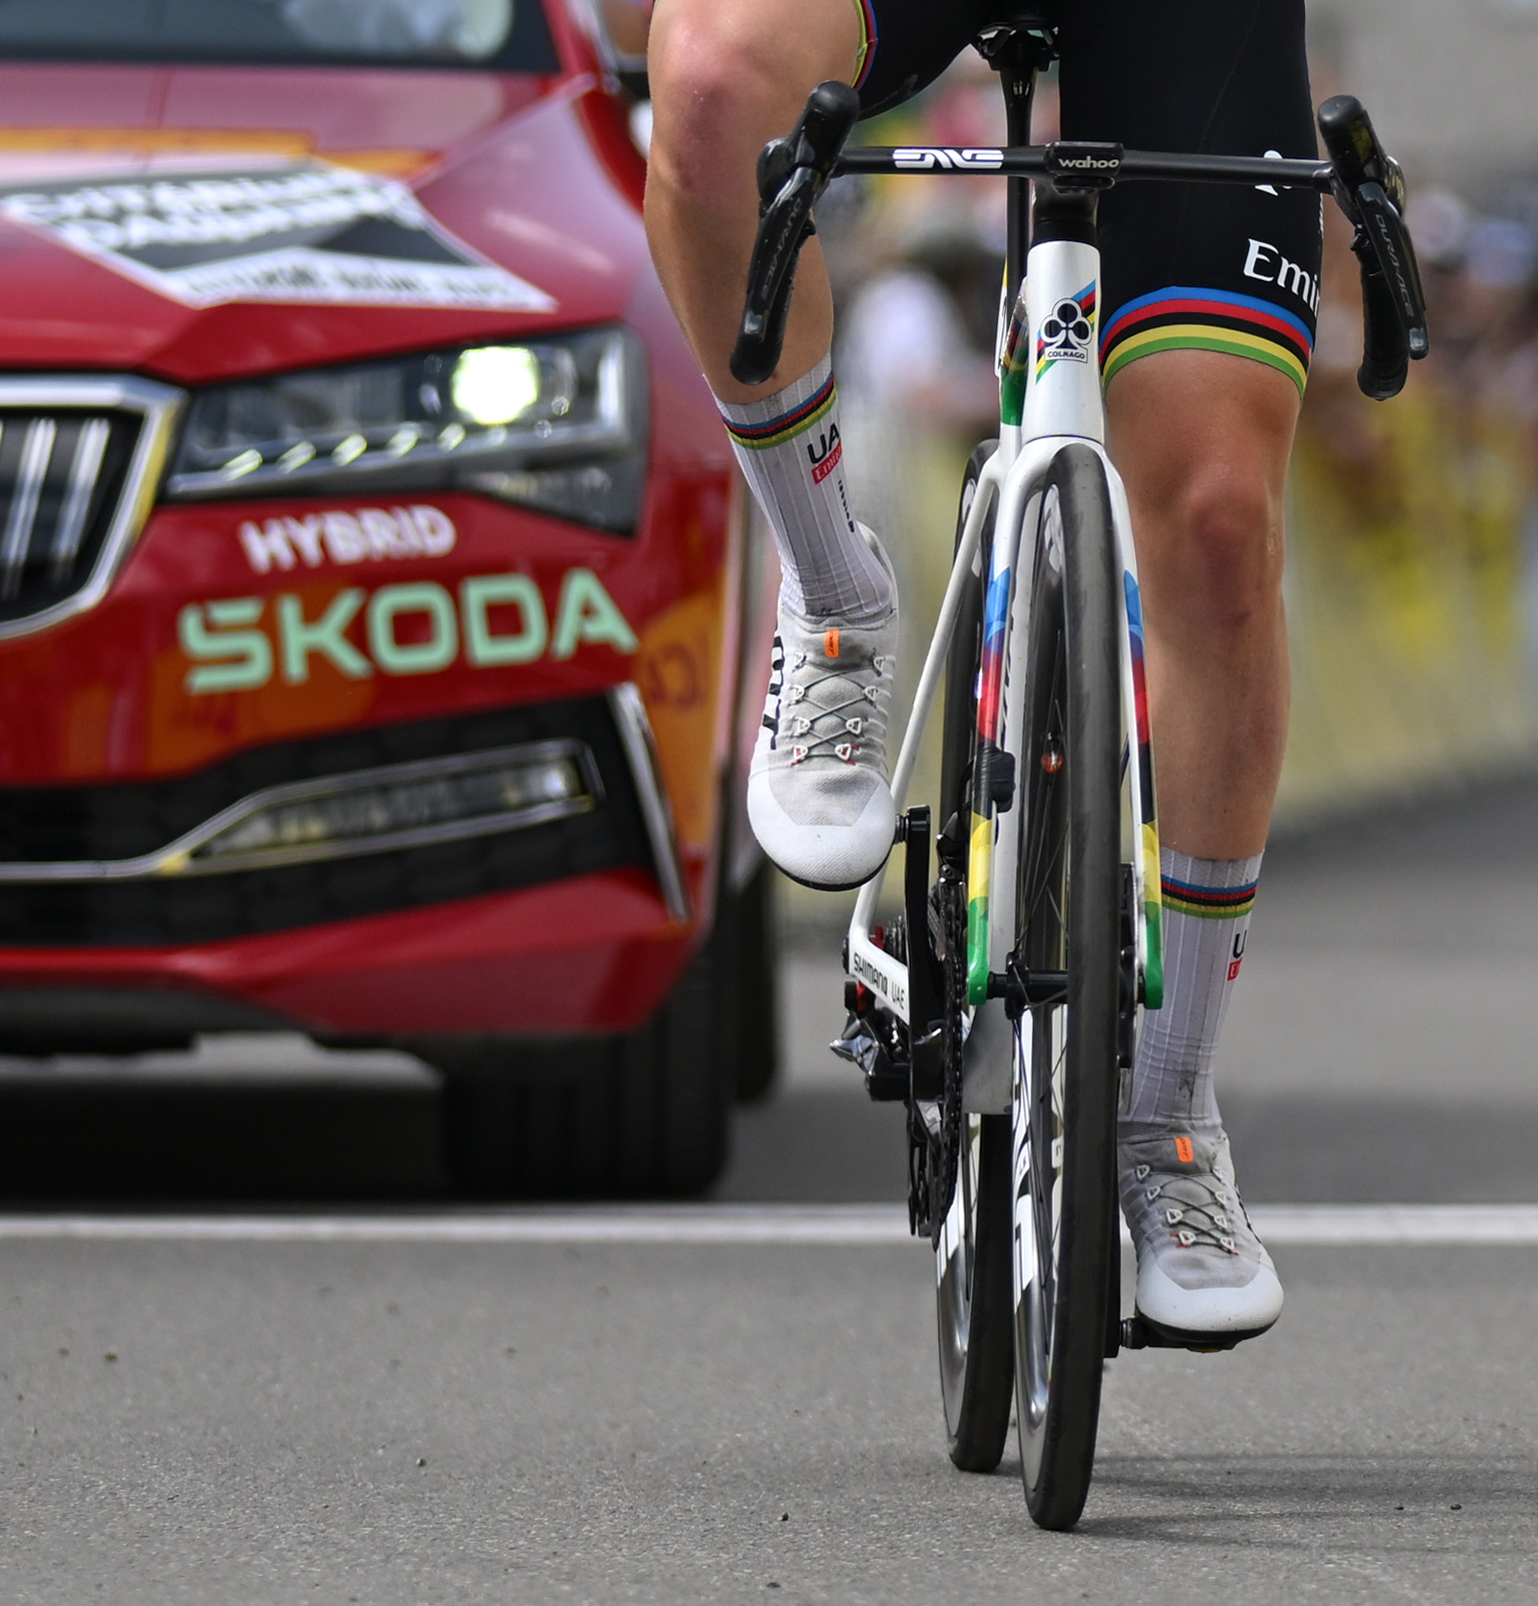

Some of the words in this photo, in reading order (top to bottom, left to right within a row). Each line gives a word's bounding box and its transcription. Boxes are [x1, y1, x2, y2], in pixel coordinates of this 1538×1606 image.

[1058, 156, 1121, 170] wahoo
[1046, 350, 1086, 360] COLNAGO
[238, 504, 458, 574] HYBRID
[853, 952, 888, 998] SHIMANO
[891, 981, 905, 1010] UAE
